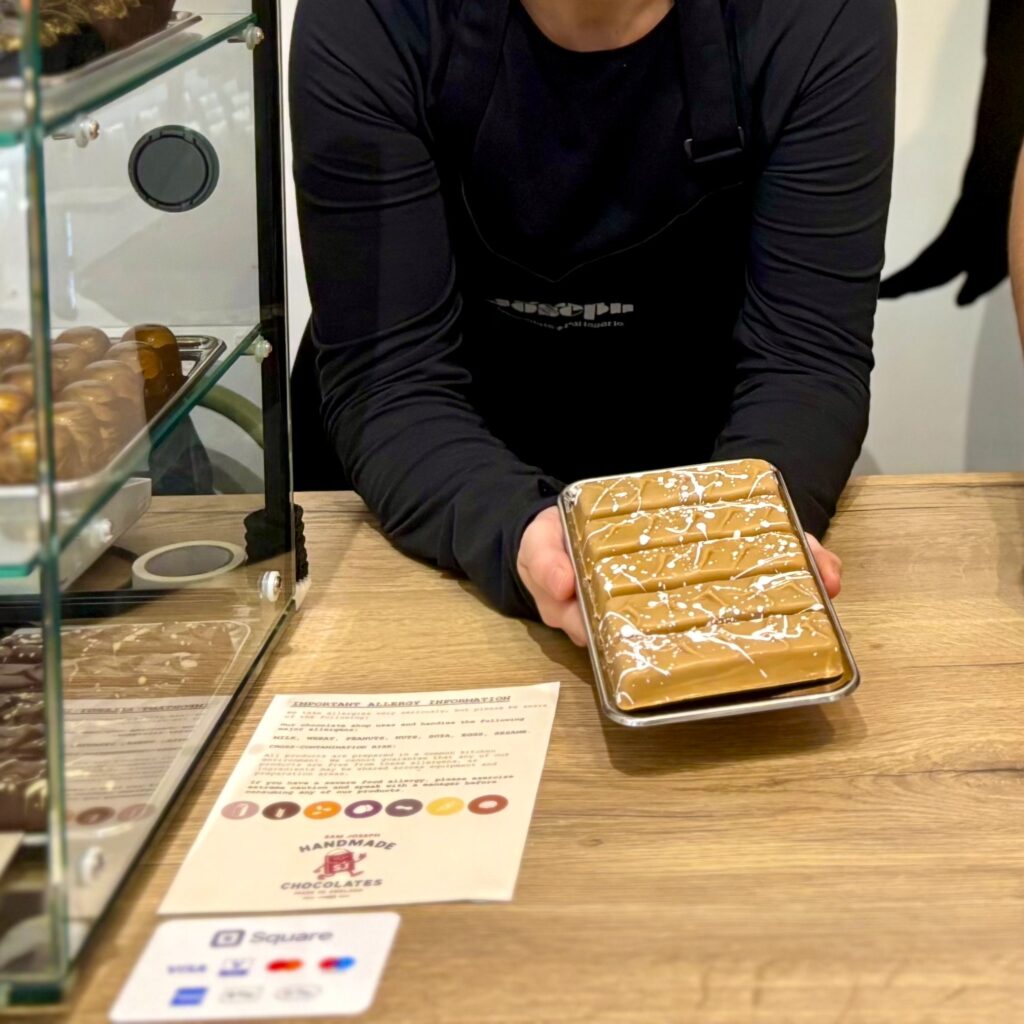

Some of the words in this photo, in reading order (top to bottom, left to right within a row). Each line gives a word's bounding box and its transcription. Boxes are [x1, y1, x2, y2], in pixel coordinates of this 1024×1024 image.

[293, 700, 361, 708] IMPORTANT
[367, 699, 420, 708] ALLERGY
[429, 695, 512, 706] INFORMATION
[299, 839, 397, 853] HANDMADE
[280, 878, 383, 891] CHOCOLATES
[249, 931, 334, 945] Square
